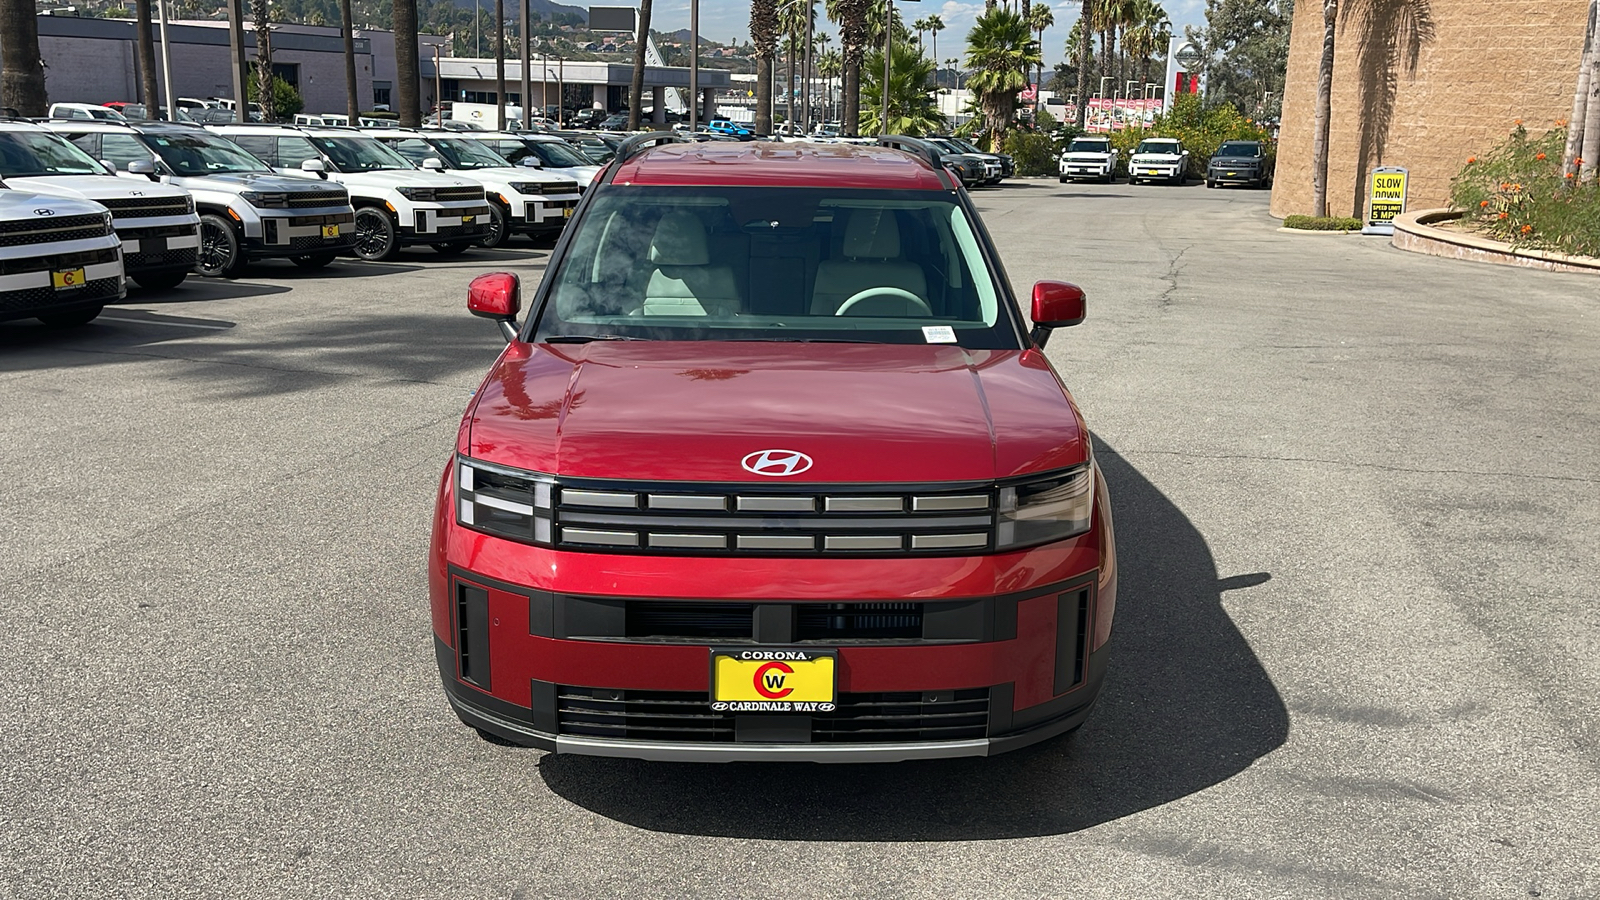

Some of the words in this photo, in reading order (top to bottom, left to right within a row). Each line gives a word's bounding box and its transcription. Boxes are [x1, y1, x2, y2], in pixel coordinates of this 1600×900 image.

[1376, 178, 1402, 188] SLOW
[1375, 190, 1401, 198] DOWN
[1372, 211, 1379, 219] 5
[741, 651, 807, 660] CORONA
[753, 661, 795, 699] C
[765, 673, 786, 689] W
[729, 701, 791, 711] CARDINALE
[794, 702, 818, 711] WAY
